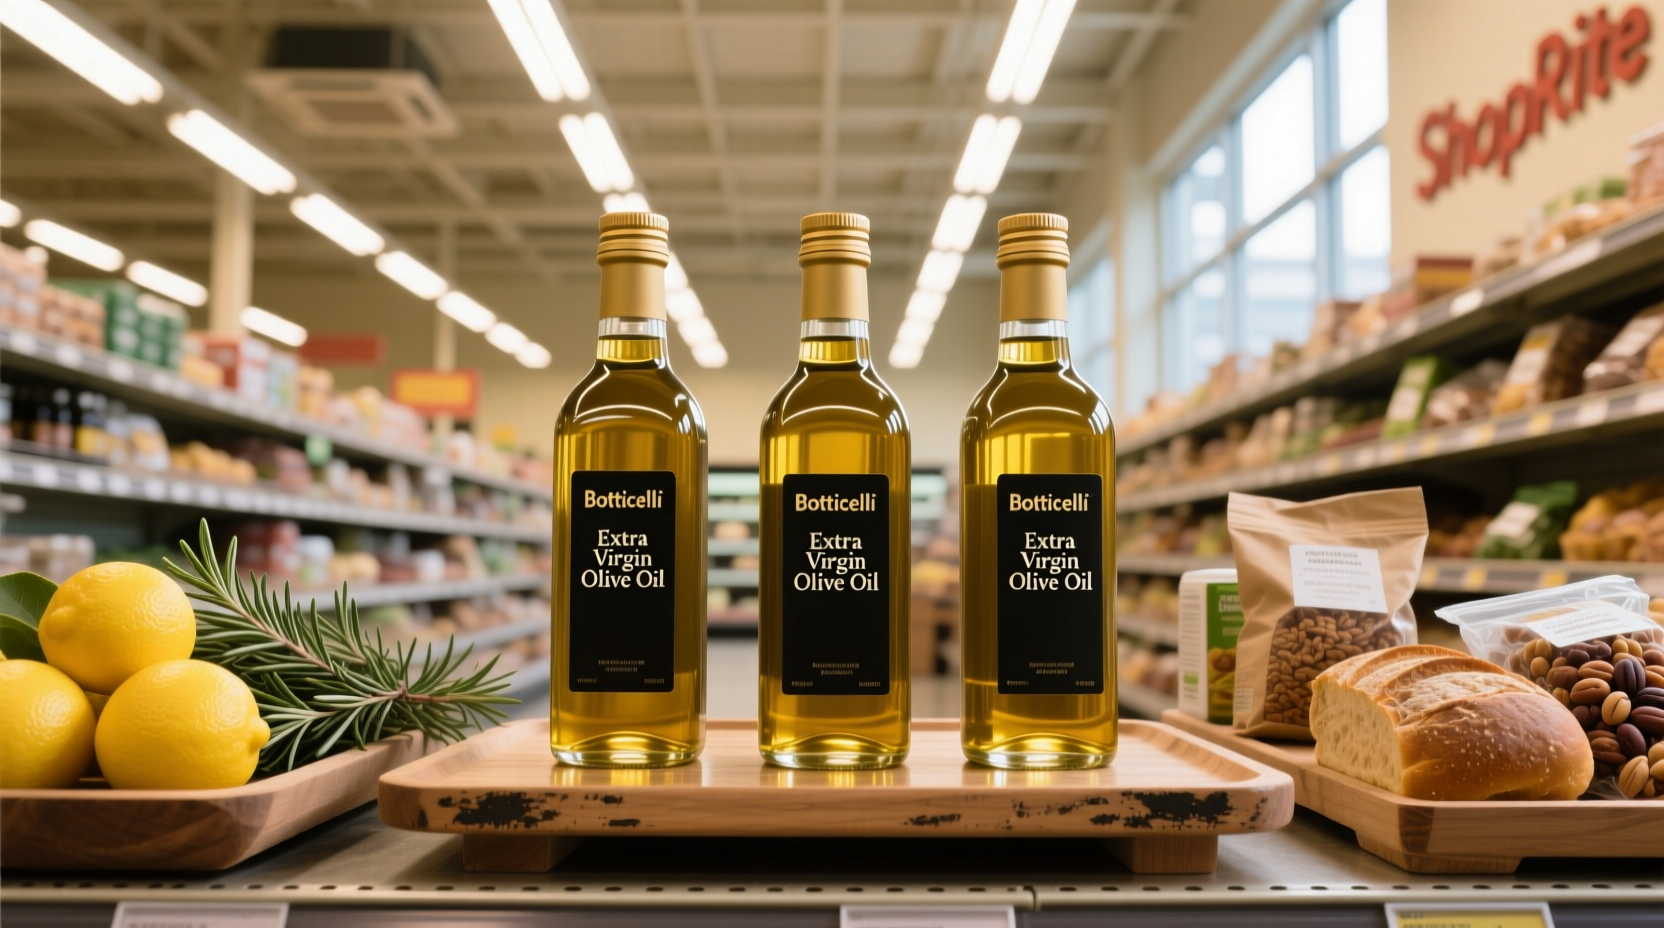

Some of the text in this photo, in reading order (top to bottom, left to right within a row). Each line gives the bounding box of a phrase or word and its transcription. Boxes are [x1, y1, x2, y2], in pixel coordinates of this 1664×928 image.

[1416, 5, 1653, 201] ShopRite
[584, 489, 663, 509] Botticelli
[795, 492, 876, 512] Botticelli
[1009, 492, 1089, 512] Botticelli
[597, 528, 648, 547] Extra
[809, 531, 863, 550] Extra
[1024, 531, 1076, 550] Extra
[593, 549, 652, 572] Virgin
[805, 552, 866, 575] Virgin
[1020, 552, 1080, 574] Virgin
[581, 569, 665, 588] Olive Oil
[794, 571, 879, 591] Olive Oil
[1009, 571, 1093, 591] Olive Oil
